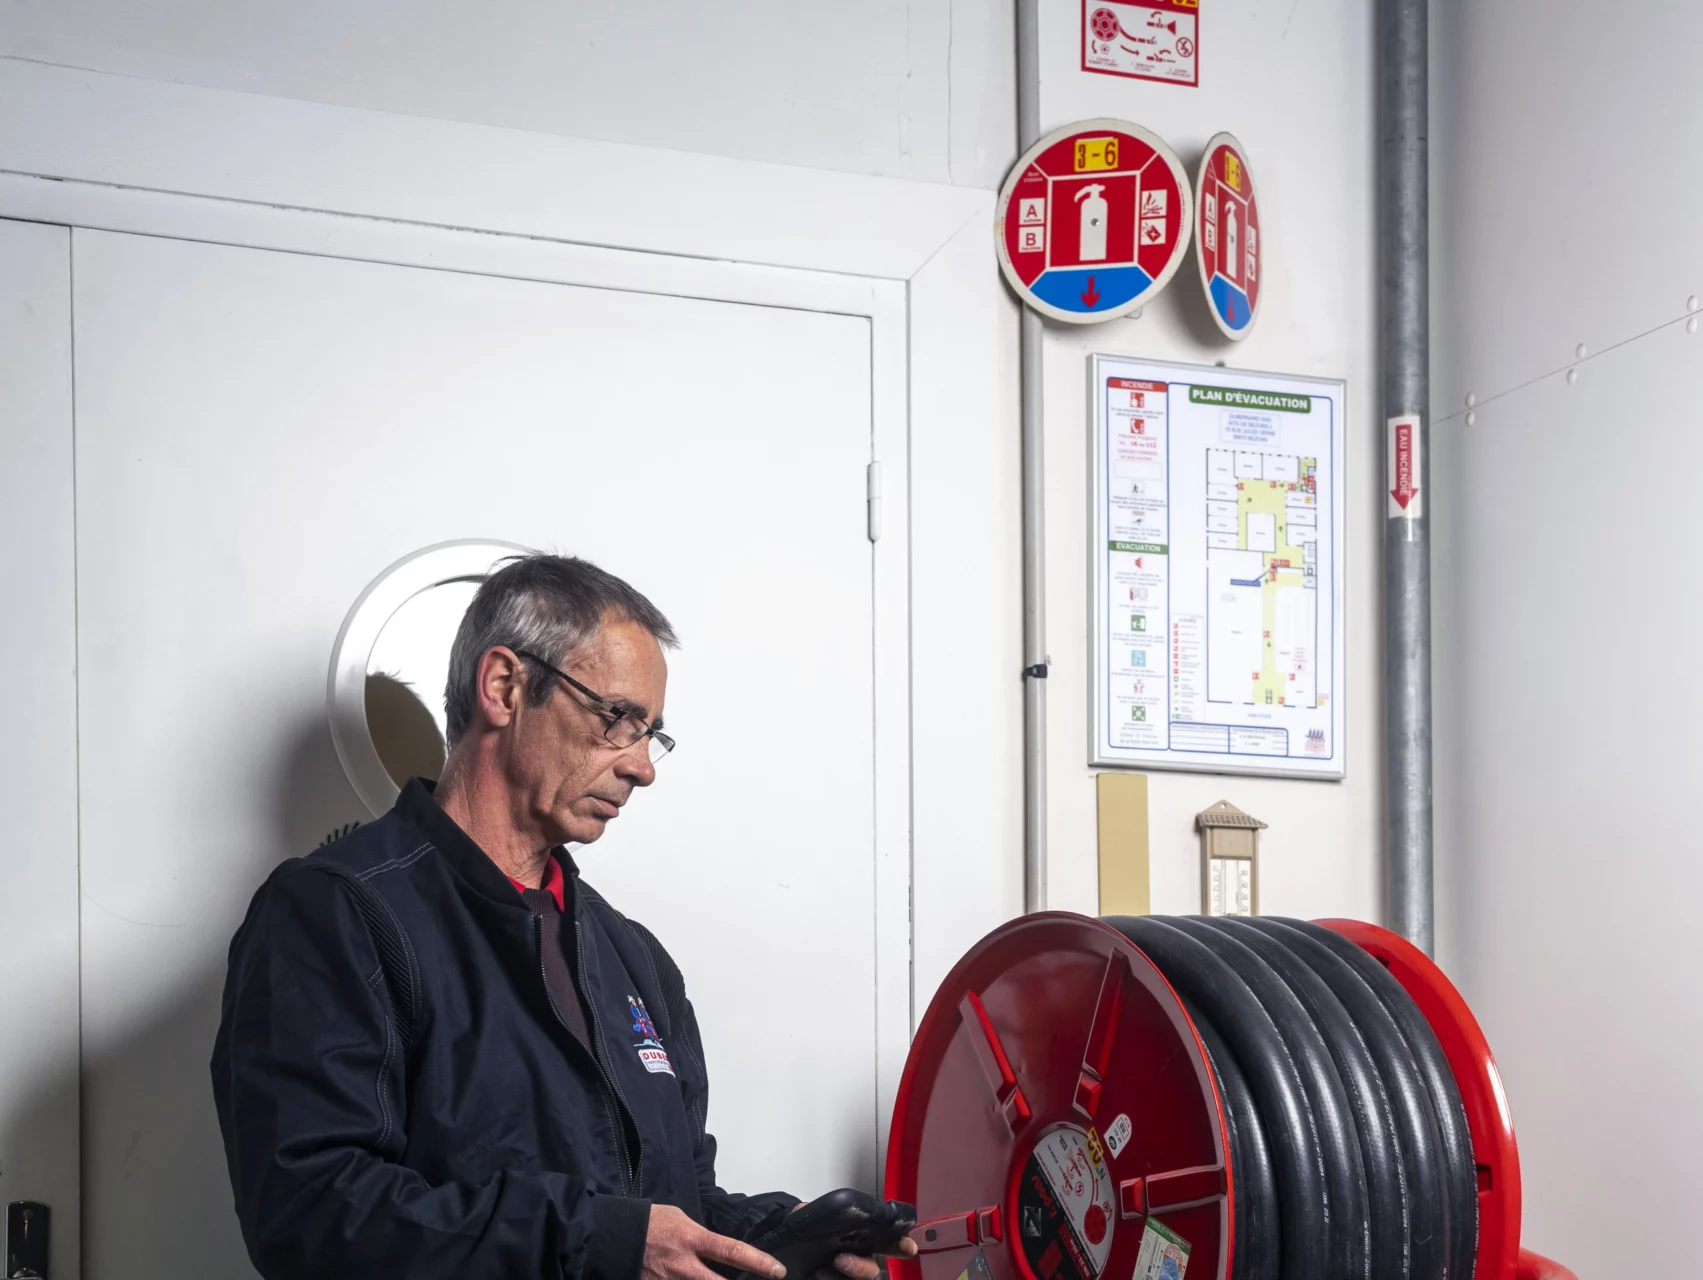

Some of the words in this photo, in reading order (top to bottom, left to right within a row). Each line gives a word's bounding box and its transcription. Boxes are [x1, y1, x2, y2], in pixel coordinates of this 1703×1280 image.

[1026, 204, 1037, 218] A
[1026, 232, 1036, 246] B
[1121, 380, 1154, 389] INCENDIE
[1192, 389, 1222, 401] PLAN
[1225, 391, 1307, 409] D'ÉVACUATION
[1399, 429, 1408, 449] EAU
[1399, 451, 1409, 496] INCENDIE
